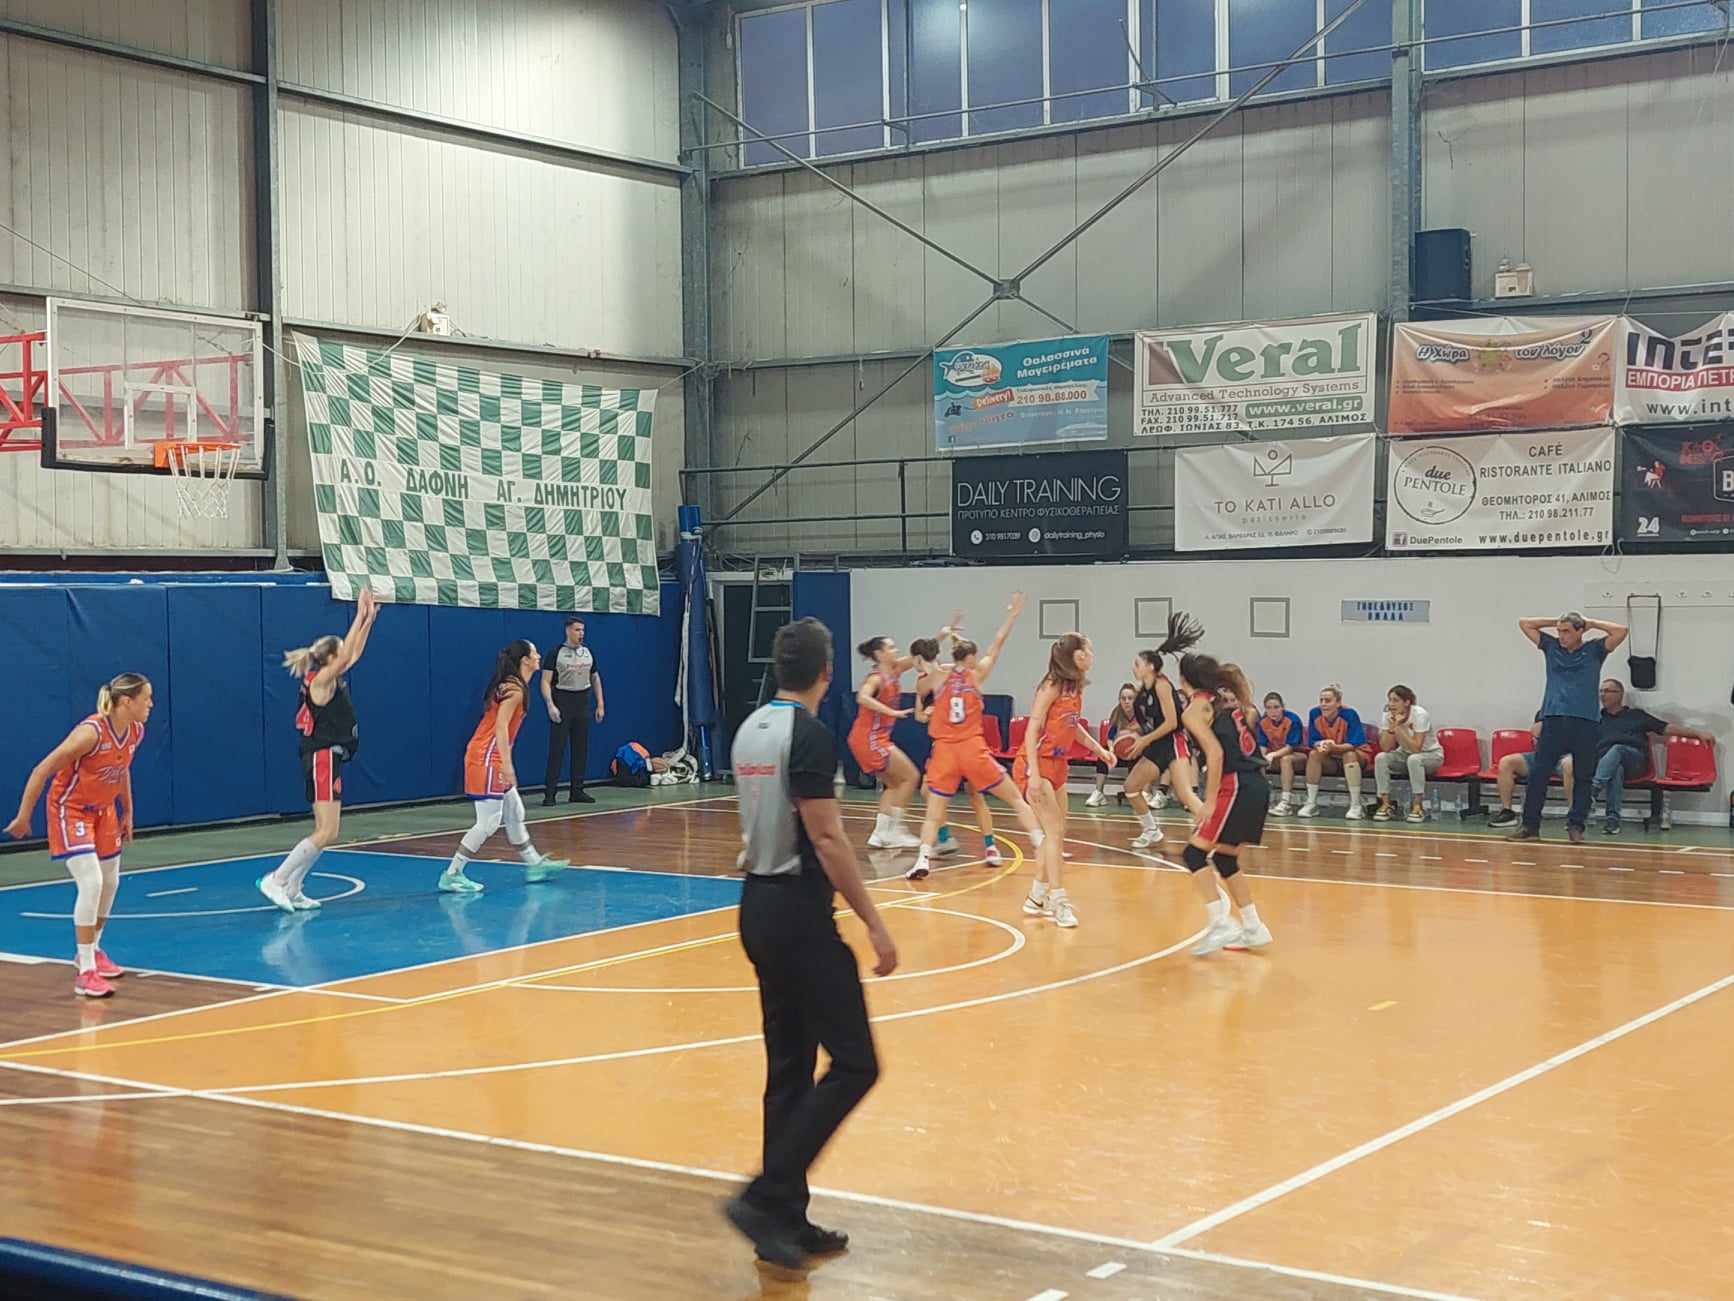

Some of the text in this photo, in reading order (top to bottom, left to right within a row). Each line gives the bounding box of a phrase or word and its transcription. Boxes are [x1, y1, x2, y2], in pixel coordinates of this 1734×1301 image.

[1023, 347, 1089, 366] Θαλασσινά
[1167, 322, 1362, 384] Veral
[1017, 356, 1097, 378] Μαγειρέματα
[1628, 371, 1695, 389] ΕΜΠΟΡΙΑ
[1151, 381, 1359, 403] Advanced Technology Systems
[1167, 407, 1185, 415] 210
[1249, 399, 1360, 415] www.veral.gr
[1166, 415, 1184, 424] 210
[1180, 423, 1222, 432] ΙΩΝΙΑΣ
[1273, 418, 1294, 427] 174
[1319, 413, 1367, 424] ΑΛΙΜΟΣ
[1425, 465, 1452, 480] due
[1480, 460, 1611, 478] RISTORANTE ITALIANO
[405, 467, 470, 499] ΔΑΦΝΗ
[496, 479, 522, 503] ΑΓ.
[534, 482, 627, 510] ΔΗΜΗΤΡΙΟΥ
[958, 476, 1121, 507] DAILY TRAINING
[1404, 476, 1467, 497] PENTOLE
[1215, 494, 1336, 513] TO KATI ALLO
[1481, 494, 1552, 506] ΘΕΟΜΗΤΟΡΟΣ
[1571, 490, 1611, 502] ΑΛΙΜΟΣ
[958, 509, 999, 520] ΠΡΟΤΥΠΟ
[1000, 507, 1035, 518] ΚΕΝΤΡΟ
[1528, 509, 1544, 519] 210
[1637, 517, 1660, 533] 24
[1410, 536, 1463, 545] DuePentole
[1479, 528, 1609, 545] www.duepentole.gr
[75, 821, 86, 837] 3
